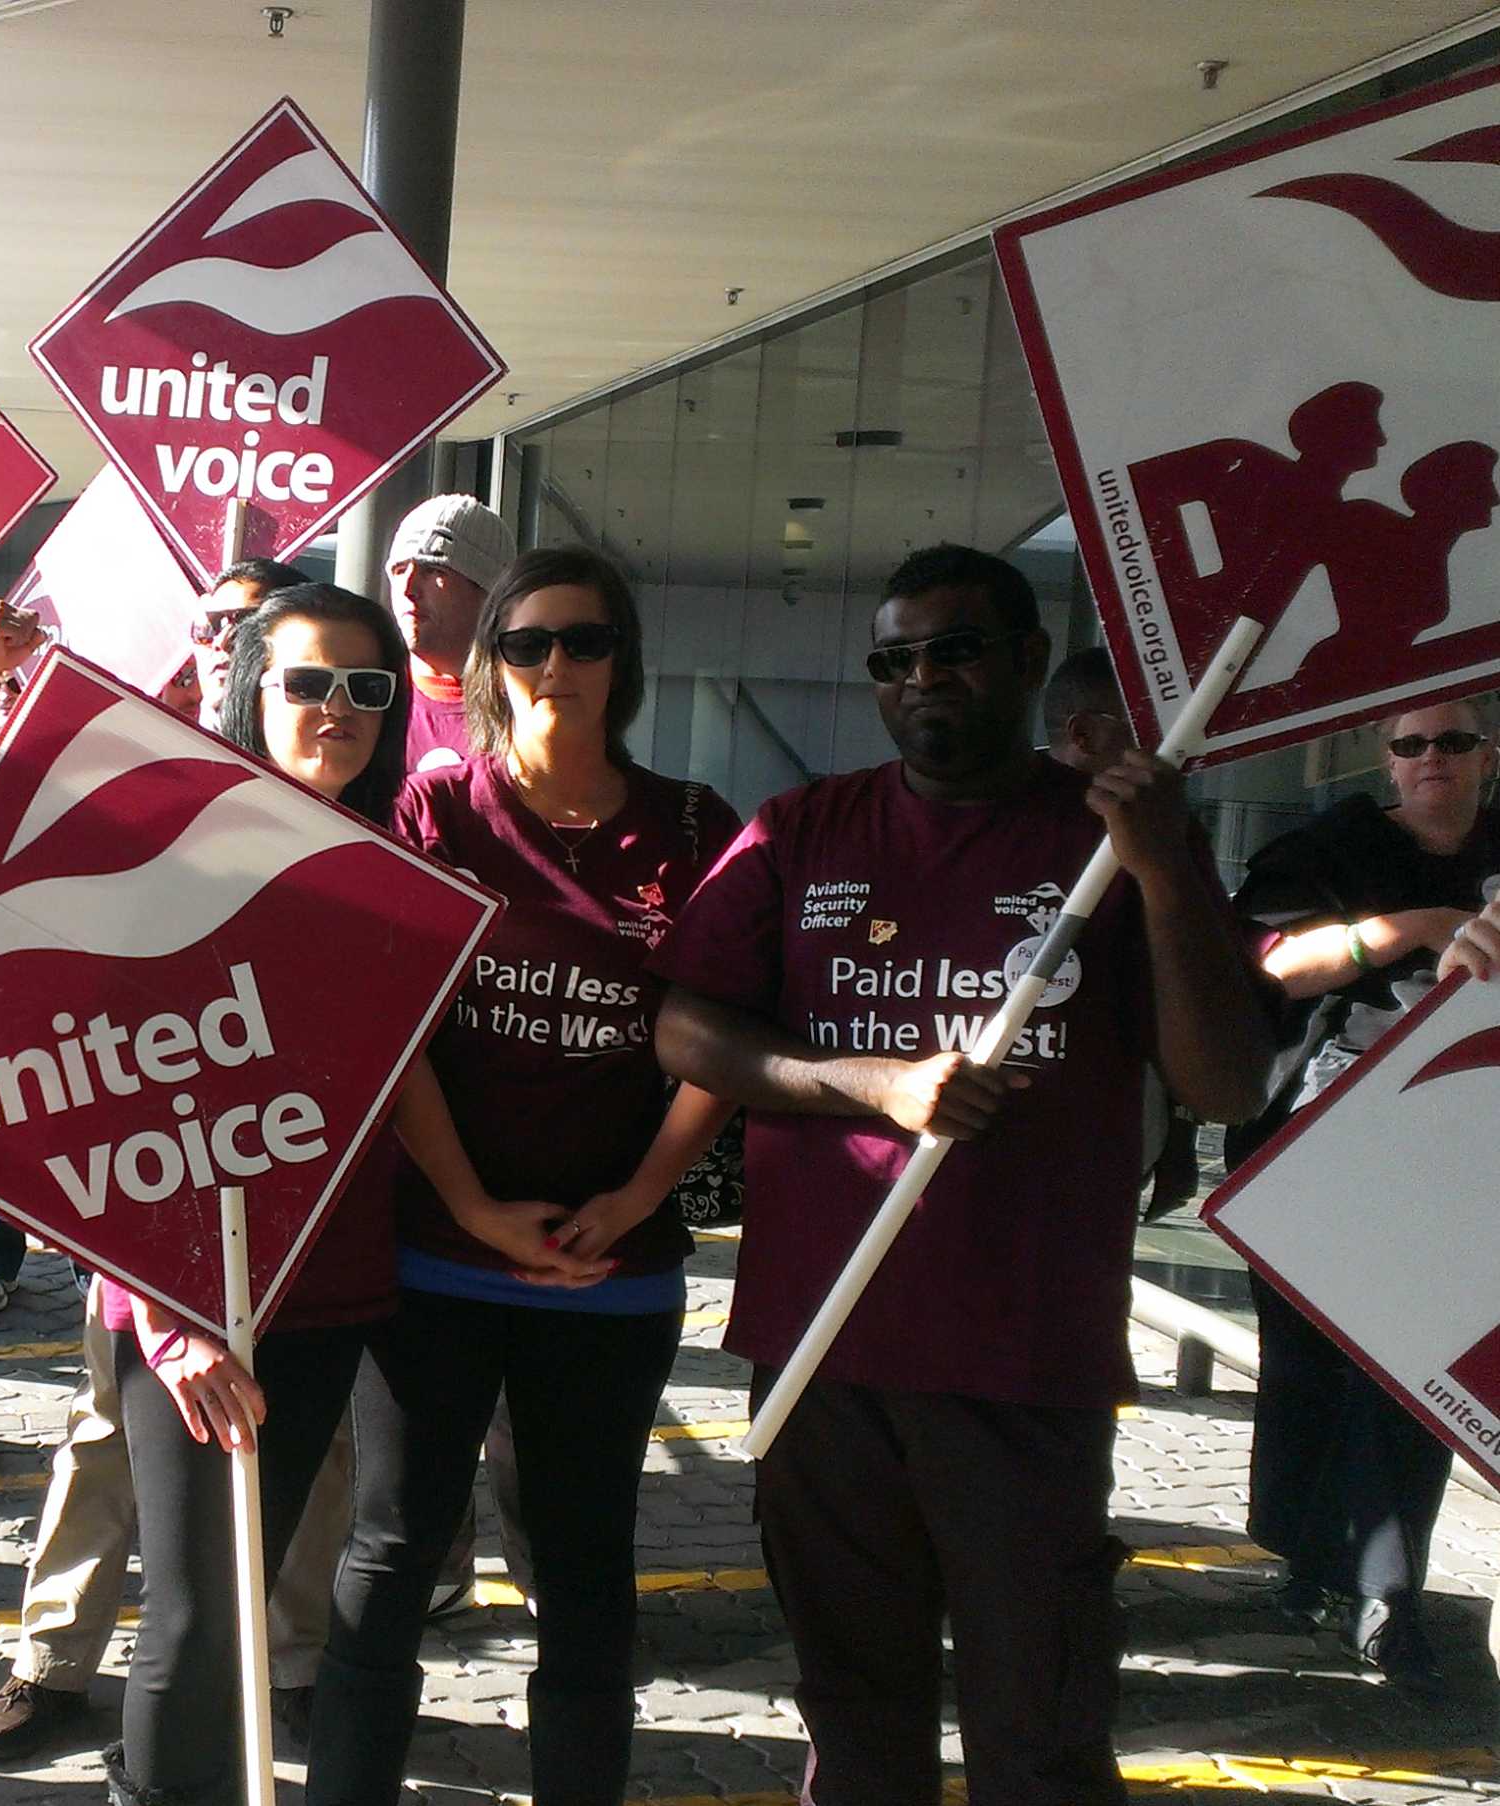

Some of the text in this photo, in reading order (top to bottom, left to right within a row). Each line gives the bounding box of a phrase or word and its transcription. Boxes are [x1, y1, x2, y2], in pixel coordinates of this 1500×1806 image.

[100, 352, 330, 426] united
[155, 432, 334, 503] voice
[1096, 468, 1180, 702] unitedvoice.org.au
[802, 897, 868, 916] Security
[805, 880, 871, 899] Aviation
[993, 895, 1038, 907] united
[994, 905, 1029, 916] voice
[799, 914, 852, 931] Officer
[1018, 946, 1041, 960] Pai
[475, 955, 641, 1006] Paid less
[831, 956, 1013, 1000] Paid les
[1045, 976, 1075, 988] est!
[456, 995, 479, 1029] in
[489, 1002, 551, 1045] the
[809, 1010, 1068, 1061] in the Wst!
[43, 1091, 329, 1220] voice
